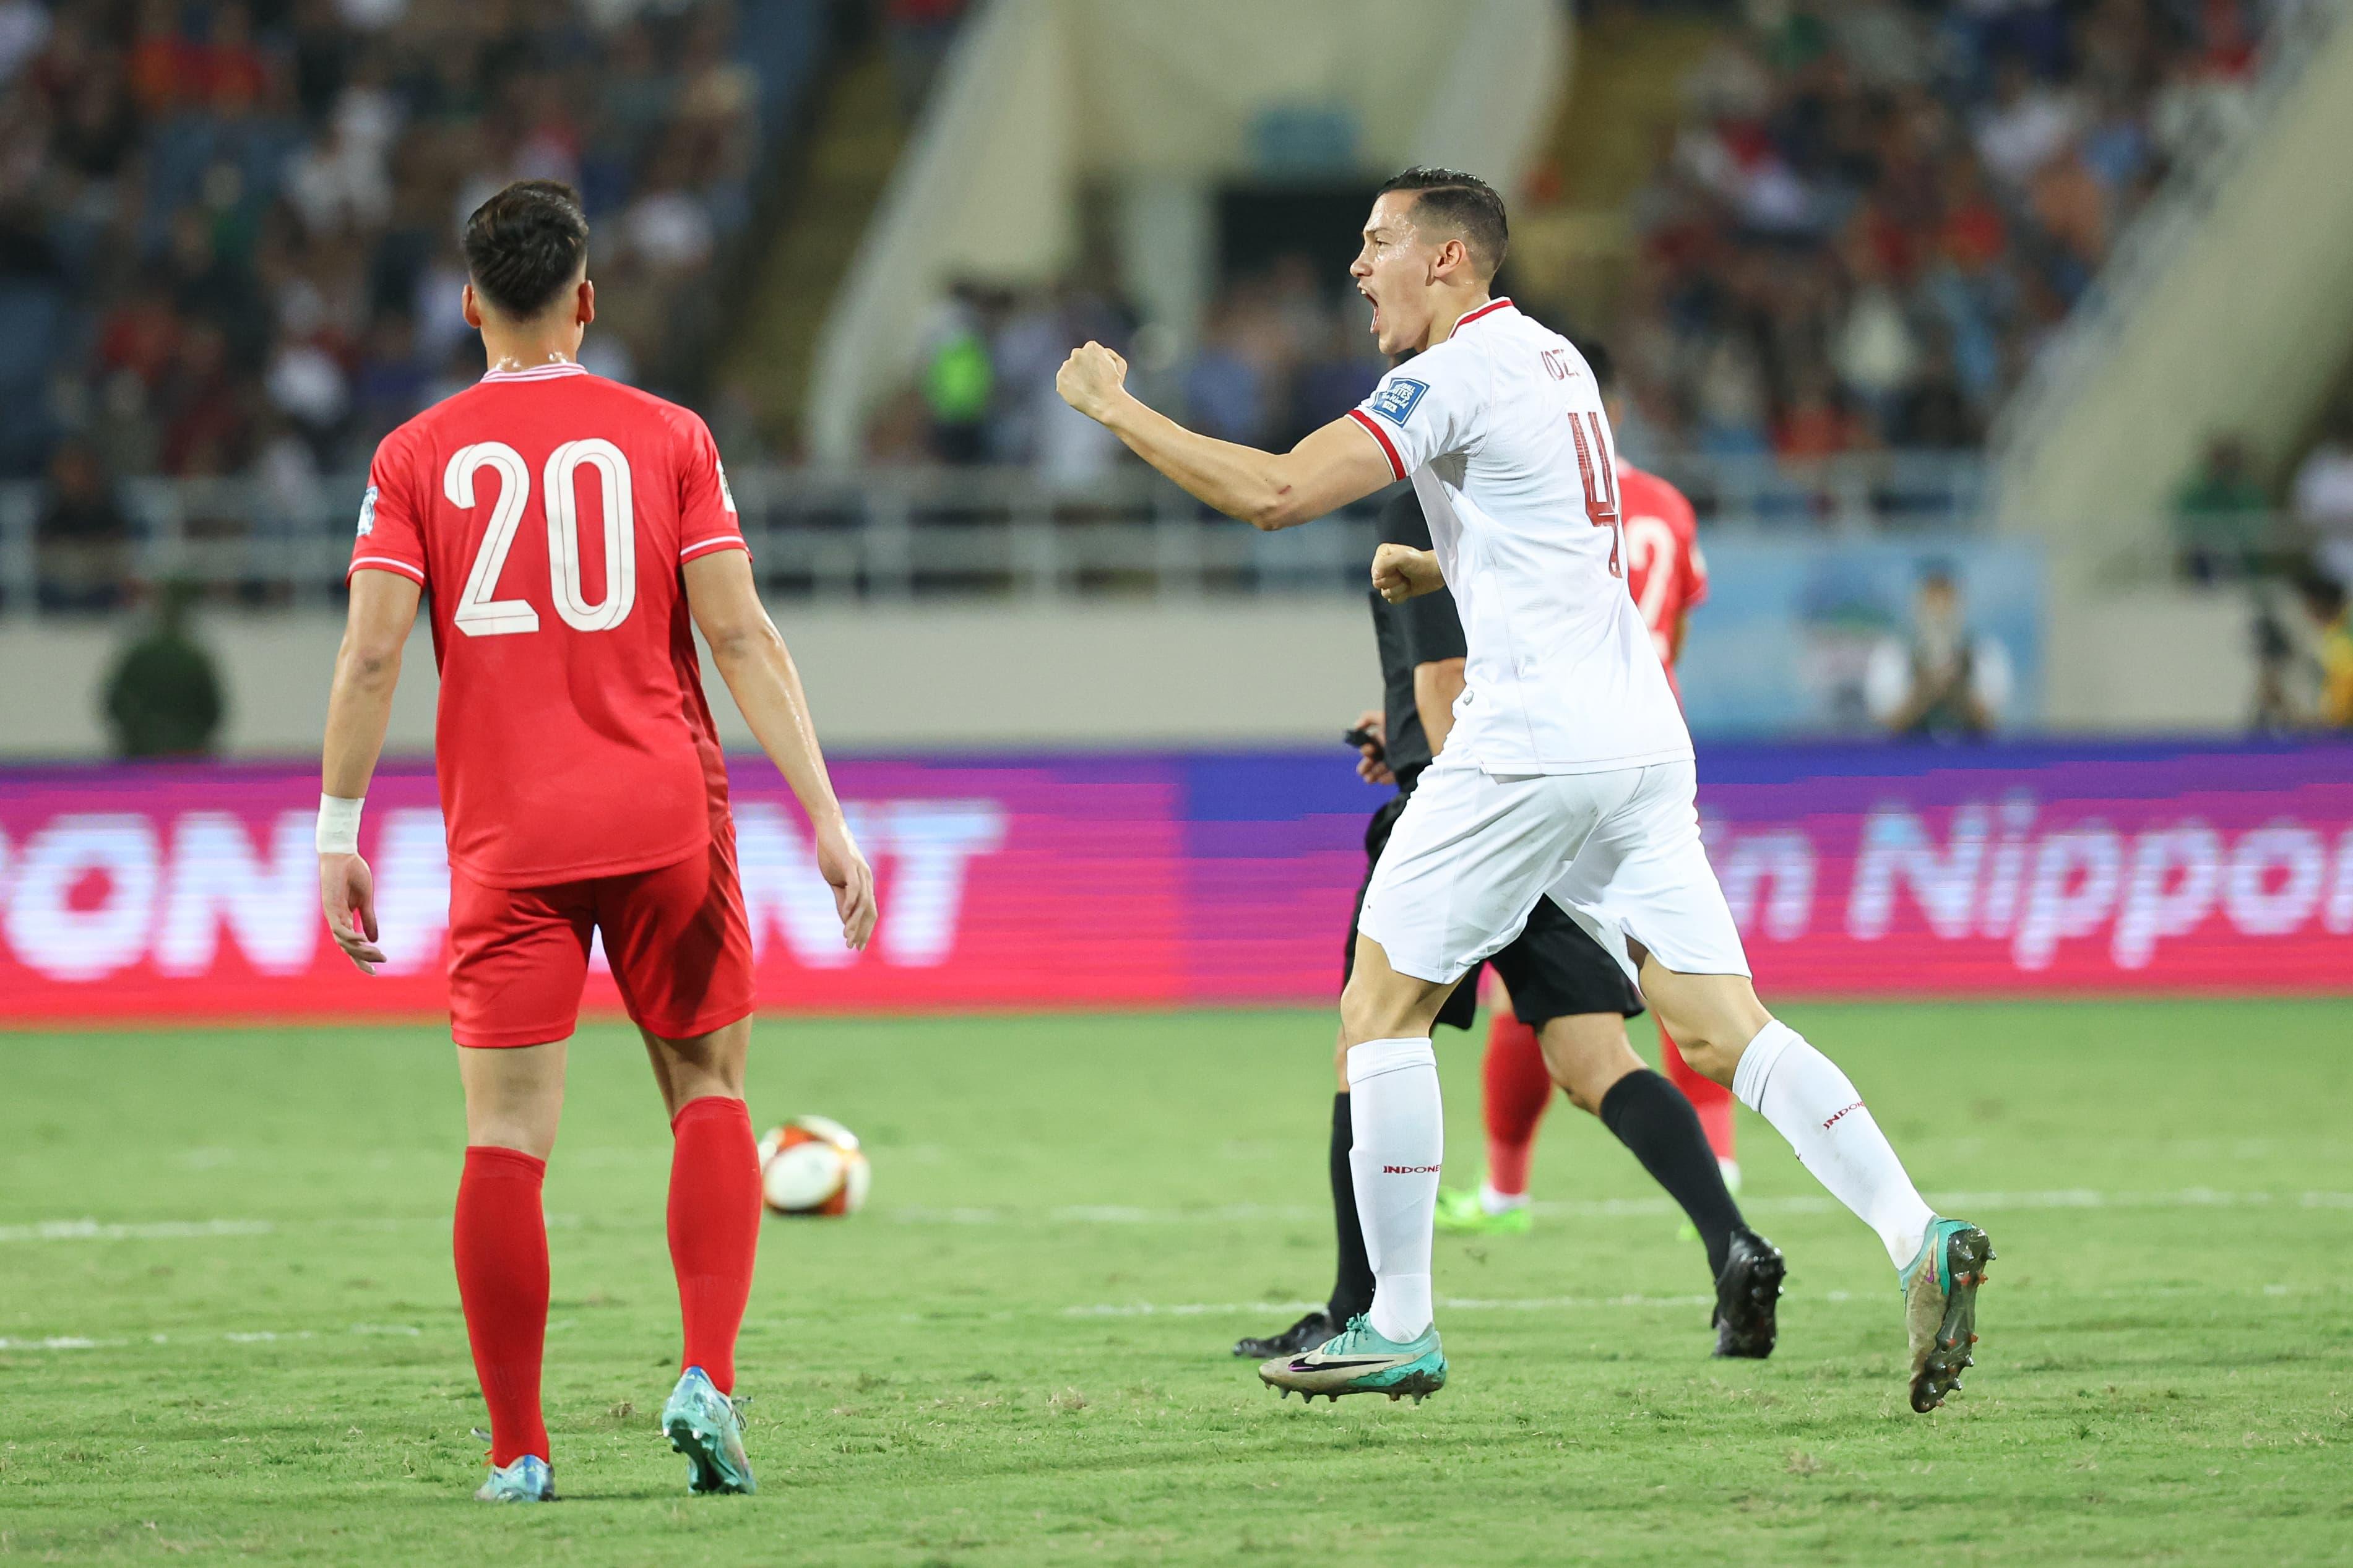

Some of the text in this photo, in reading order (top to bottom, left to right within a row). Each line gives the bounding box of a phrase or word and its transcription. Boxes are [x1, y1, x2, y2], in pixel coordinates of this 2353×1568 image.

[443, 438, 636, 637] 20
[1567, 411, 1623, 579] 4
[0, 809, 327, 983] ON
